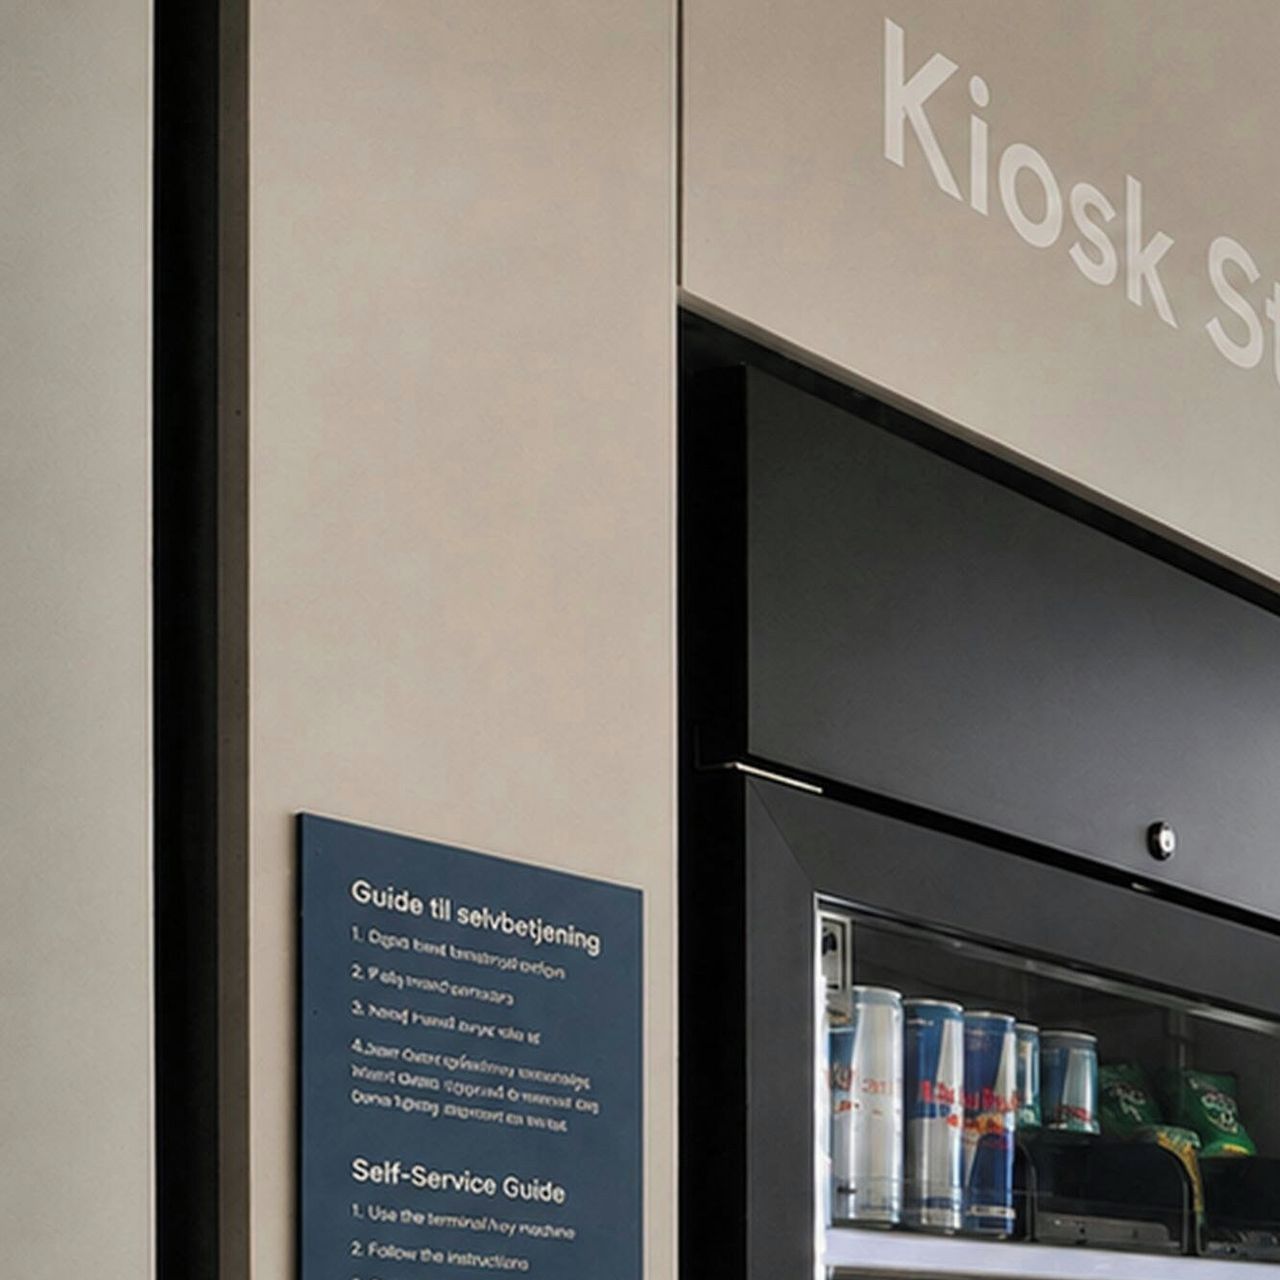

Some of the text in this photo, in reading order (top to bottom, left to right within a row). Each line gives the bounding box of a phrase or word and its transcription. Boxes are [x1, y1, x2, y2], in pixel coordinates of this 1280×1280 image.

[883, 17, 1179, 328] Kiosk
[351, 880, 424, 916] Guide
[430, 898, 451, 921] til
[458, 906, 601, 956] selvbetjening
[352, 1158, 566, 1204] Self-Service Guide
[367, 1205, 398, 1223] Use
[400, 1209, 425, 1225] the
[367, 1242, 417, 1261] Follow
[420, 1248, 444, 1264] the
